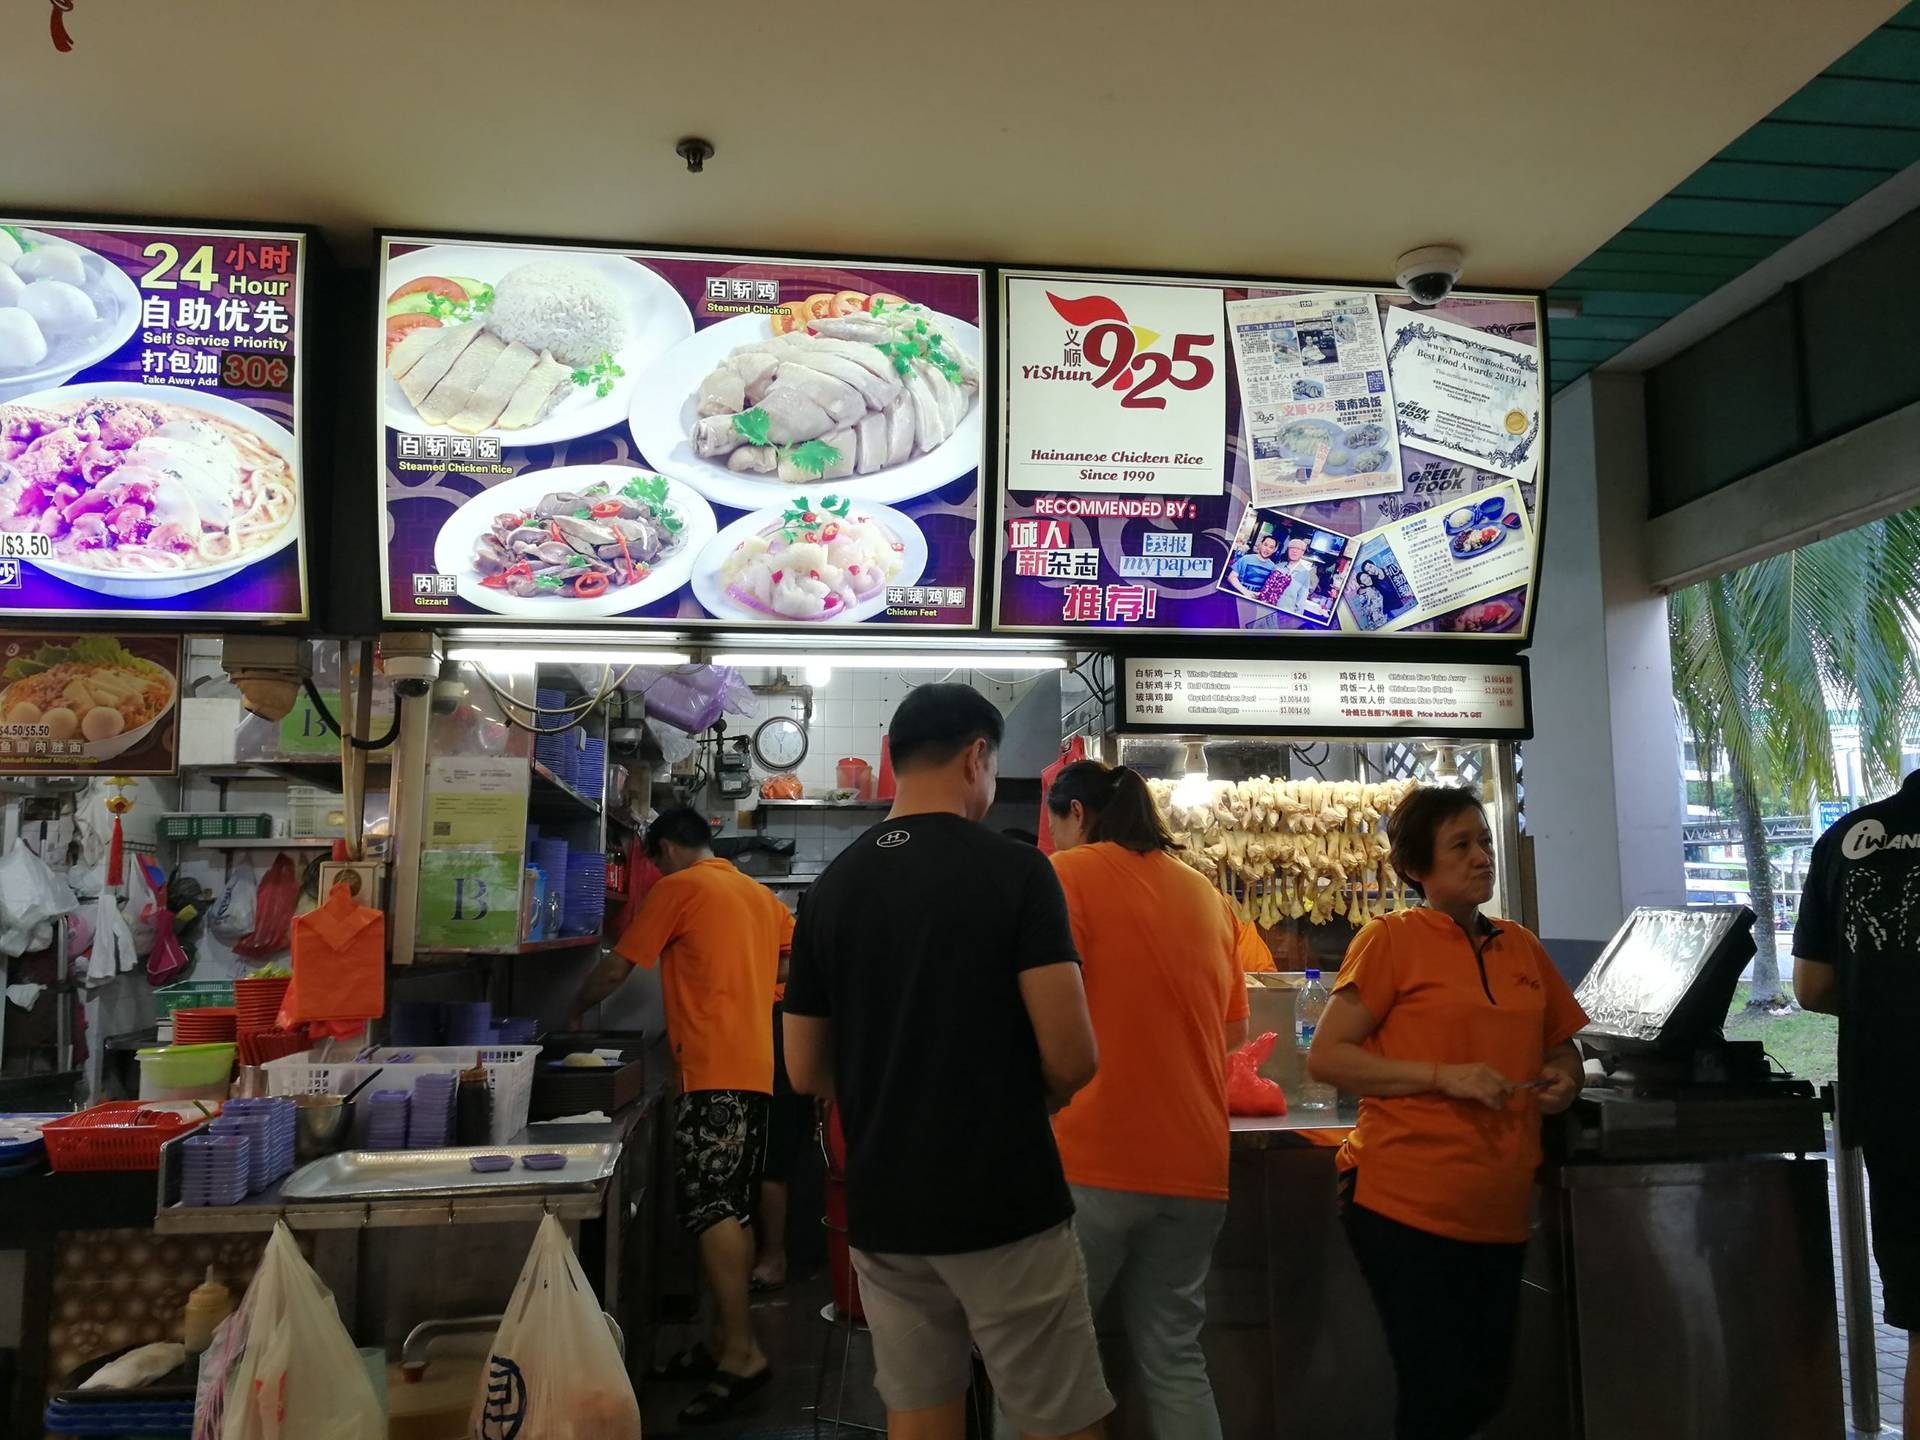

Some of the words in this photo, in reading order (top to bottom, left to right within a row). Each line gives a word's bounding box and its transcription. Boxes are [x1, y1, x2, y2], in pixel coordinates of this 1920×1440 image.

[140, 242, 218, 292] 24
[225, 243, 291, 273] 小时
[229, 275, 289, 296] Hour
[711, 281, 777, 300] 白斩鸡
[142, 295, 289, 334] 自助优先
[707, 303, 750, 313] Steamed
[752, 305, 791, 315] Chicken
[143, 333, 172, 344] Self
[176, 334, 230, 346] Service
[234, 336, 288, 352] Priority
[1064, 328, 1082, 368] 义顺
[1427, 342, 1522, 375] www.TheGreenBook.com
[142, 349, 218, 374] 打包加
[224, 354, 288, 387] 30¢
[1022, 365, 1093, 382] YiShun
[1082, 323, 1214, 410] 925
[1417, 348, 1434, 361] Best
[1438, 355, 1458, 368] Food
[1460, 362, 1493, 378] Awards
[1494, 372, 1526, 388] 2013/14
[142, 375, 165, 384] Take
[168, 376, 196, 387] Away
[198, 377, 218, 386] Add
[1398, 402, 1430, 416] GREEN
[1400, 410, 1430, 422] BOOK
[402, 437, 497, 458] 白斩鸡饭
[1030, 450, 1108, 462] Hainanese
[1112, 452, 1169, 464] Chicken
[1174, 454, 1204, 464] Rice
[399, 462, 446, 472] Steamed
[448, 463, 488, 473] Chicken
[492, 464, 513, 474] Rice
[1424, 462, 1442, 470] THE
[1080, 470, 1118, 481] Since
[1122, 471, 1155, 482] 1990
[1408, 467, 1464, 482] GREEN
[1414, 478, 1466, 494] BOOK
[1036, 500, 1162, 516] RECOMMENDED
[1019, 550, 1097, 576] 新杂志
[1122, 557, 1212, 576] mypaper
[418, 576, 454, 593] 内脏
[415, 598, 448, 606] Gizzard
[886, 608, 918, 616] Chicken
[1136, 668, 1182, 678] 白斩鸡一只
[1294, 672, 1308, 680] $26
[1340, 672, 1376, 680] 鸡饭打包
[1136, 681, 1182, 690] 白斩鸡半只
[1340, 684, 1385, 692] 鸡饭一人份
[1340, 696, 1386, 704] 鸡饭双人份
[1136, 704, 1164, 714] 鸡内脏
[451, 878, 488, 921] B
